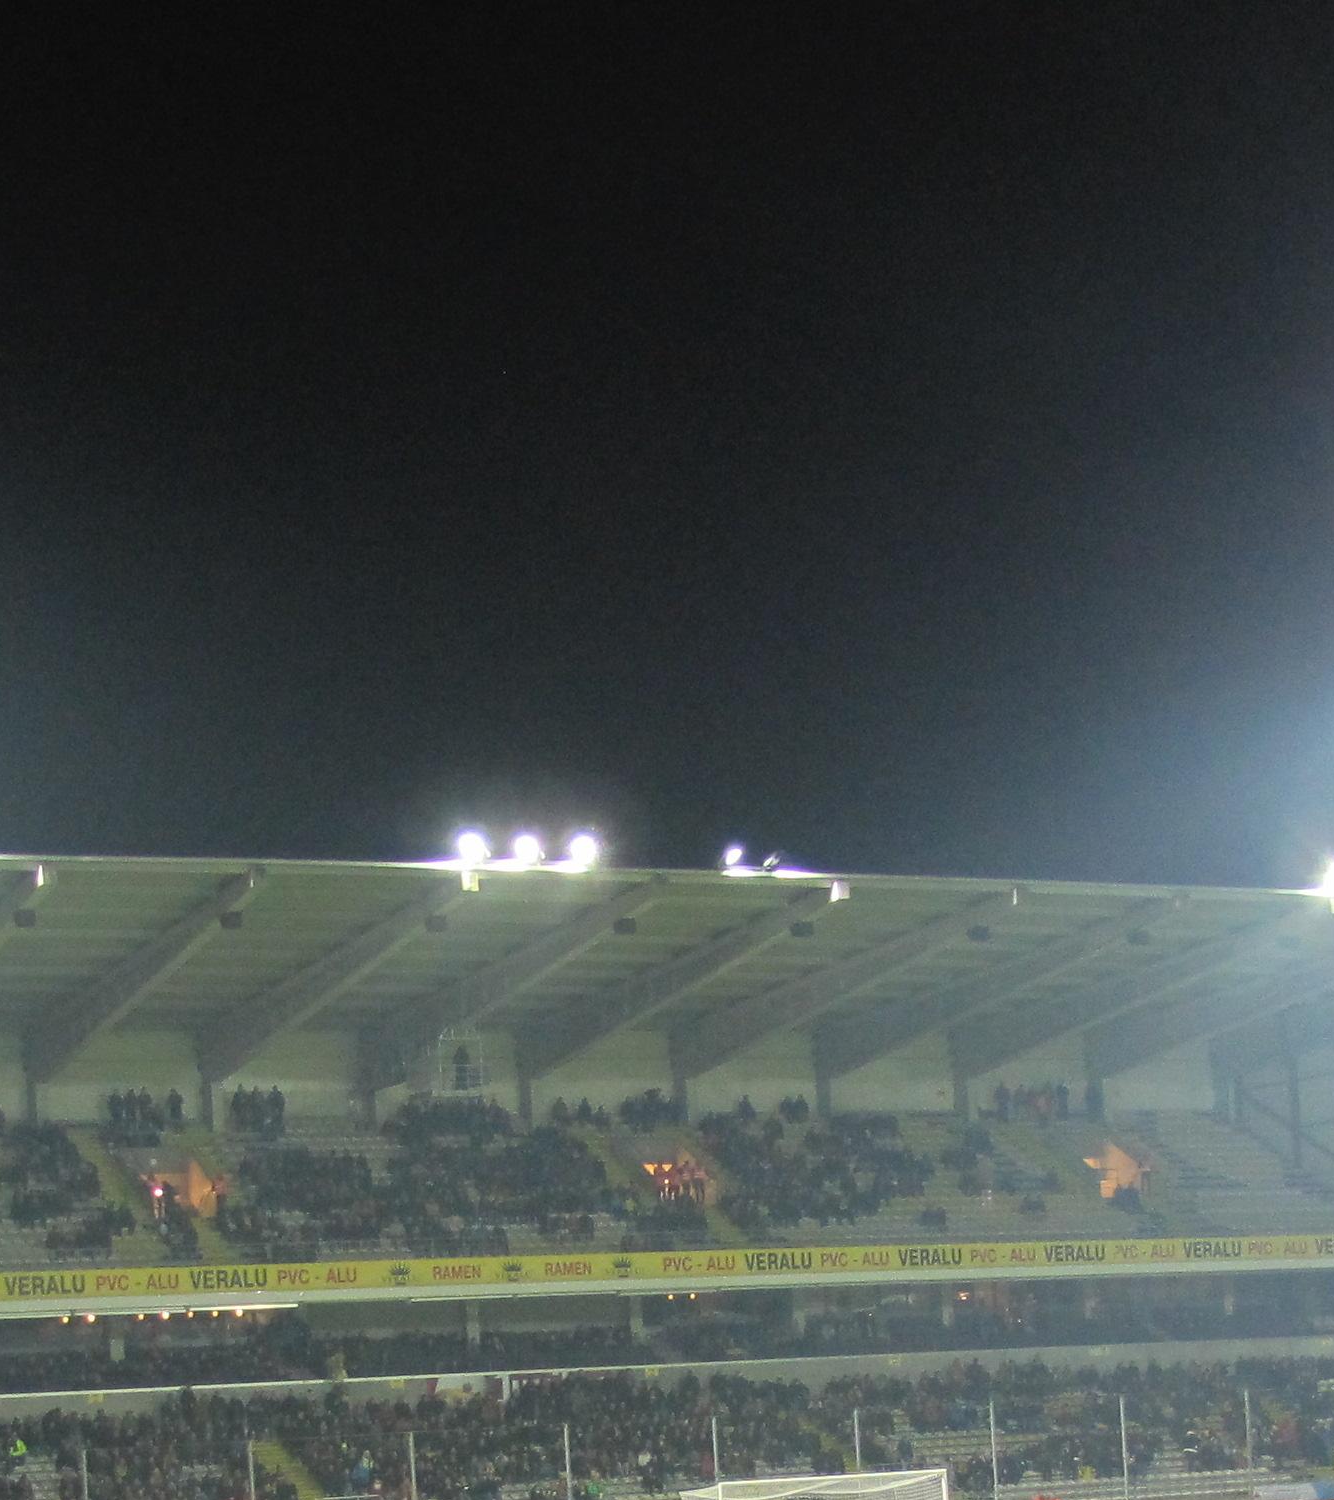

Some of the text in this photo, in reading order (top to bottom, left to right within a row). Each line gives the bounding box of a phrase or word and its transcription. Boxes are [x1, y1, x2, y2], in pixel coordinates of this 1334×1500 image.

[4, 1274, 86, 1296] VERALU
[95, 1274, 130, 1292] PVC
[146, 1272, 180, 1290] ALU
[189, 1268, 268, 1290] VERALU
[276, 1268, 311, 1285] PVC
[326, 1266, 357, 1283] ALU
[432, 1265, 482, 1281] RAMEN
[544, 1261, 593, 1276] RAMEN
[662, 1255, 693, 1272] PVC
[706, 1254, 735, 1271] ALU
[744, 1252, 813, 1271] VERALU
[820, 1253, 849, 1268] PVC
[862, 1251, 890, 1266] ALU
[898, 1248, 962, 1266] VERALU
[1043, 1244, 1106, 1262] VERALU
[1183, 1241, 1242, 1259] VERALU
